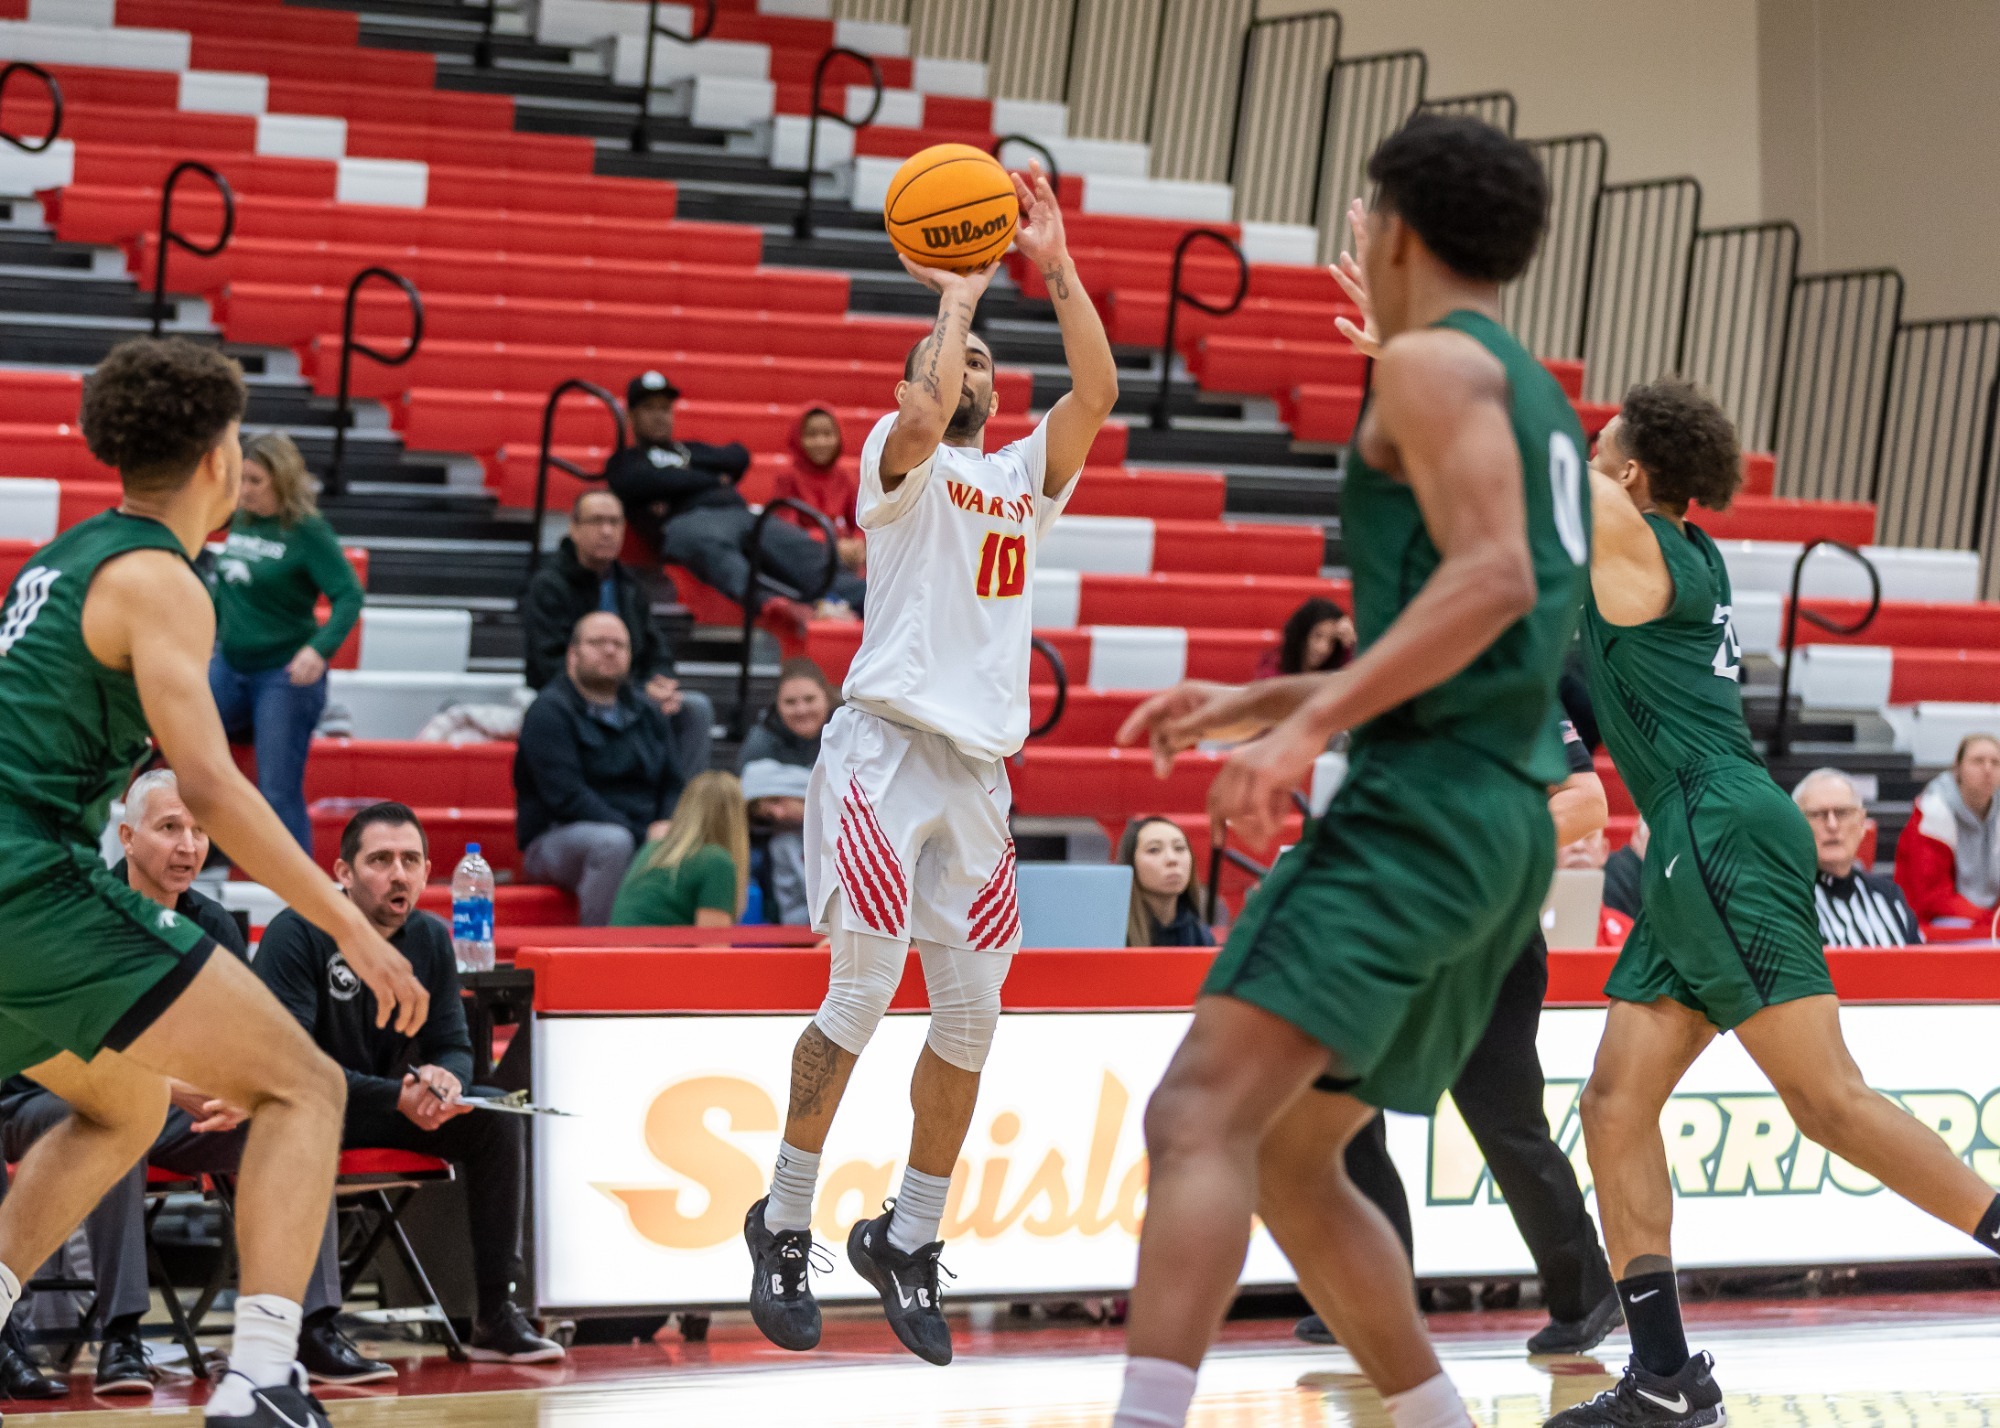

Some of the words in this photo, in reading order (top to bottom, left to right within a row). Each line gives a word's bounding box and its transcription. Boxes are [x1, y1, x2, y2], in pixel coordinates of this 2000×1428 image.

[921, 214, 1008, 249] Wilson
[975, 529, 1027, 599] 10
[1426, 1077, 2000, 1206] WRRIR
